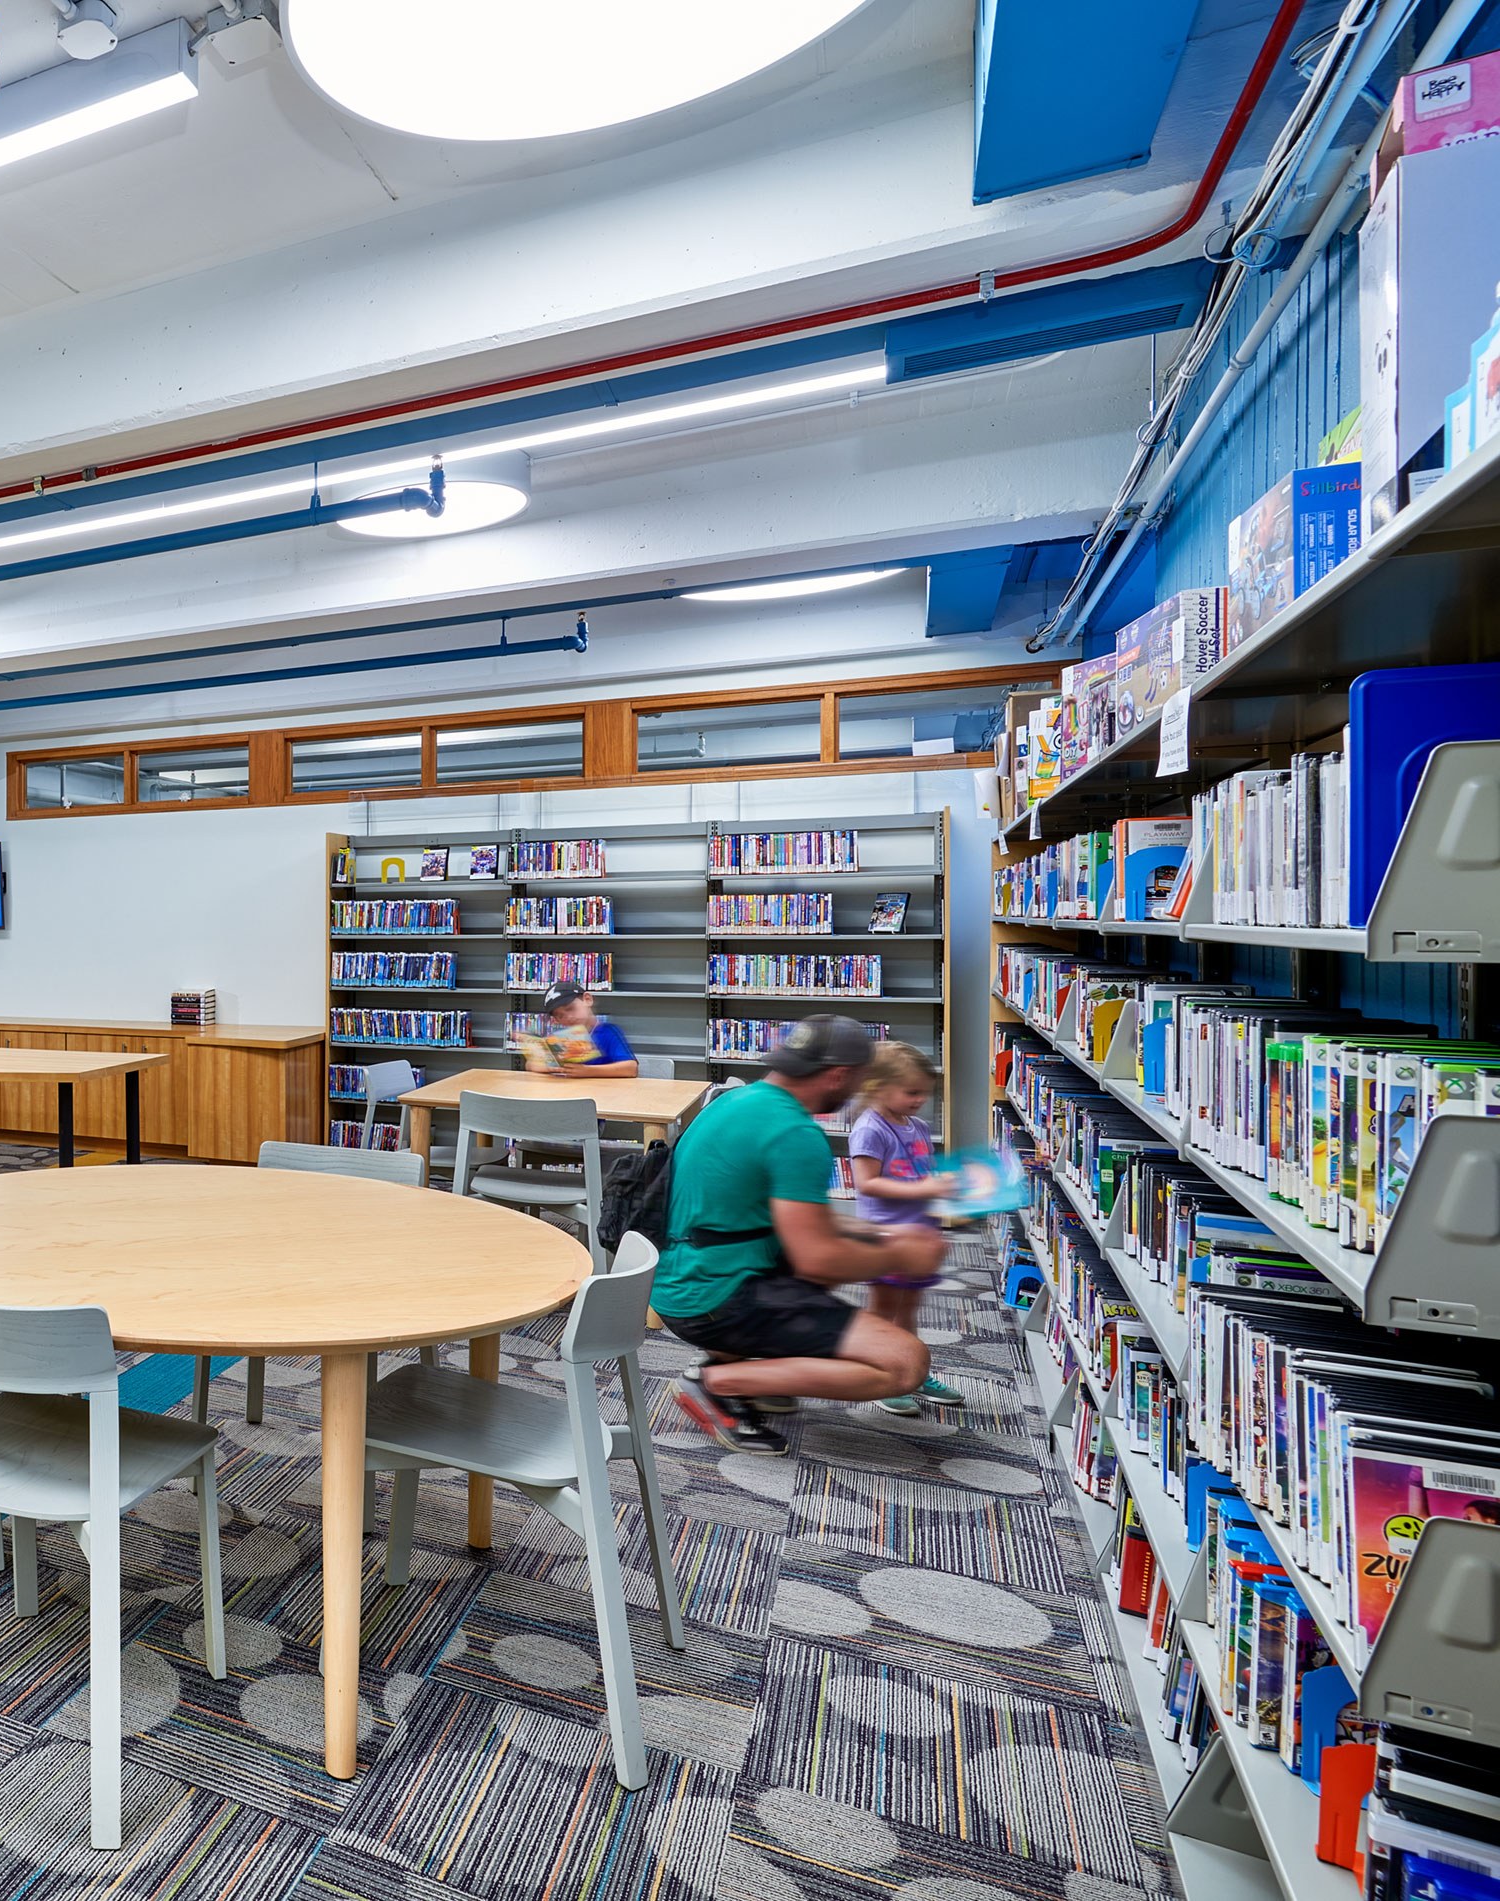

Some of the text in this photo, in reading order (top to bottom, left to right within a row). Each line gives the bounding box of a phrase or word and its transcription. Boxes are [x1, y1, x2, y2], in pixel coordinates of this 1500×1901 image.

[1428, 75, 1457, 91] Bee
[1301, 478, 1361, 497] Sillbird
[1347, 508, 1357, 558] SOLAR ROB
[1196, 594, 1208, 673] Hover Soccer
[1208, 627, 1220, 647] Set
[1277, 1283, 1330, 1296] XBOX 360
[1362, 1553, 1409, 1580] ZU
